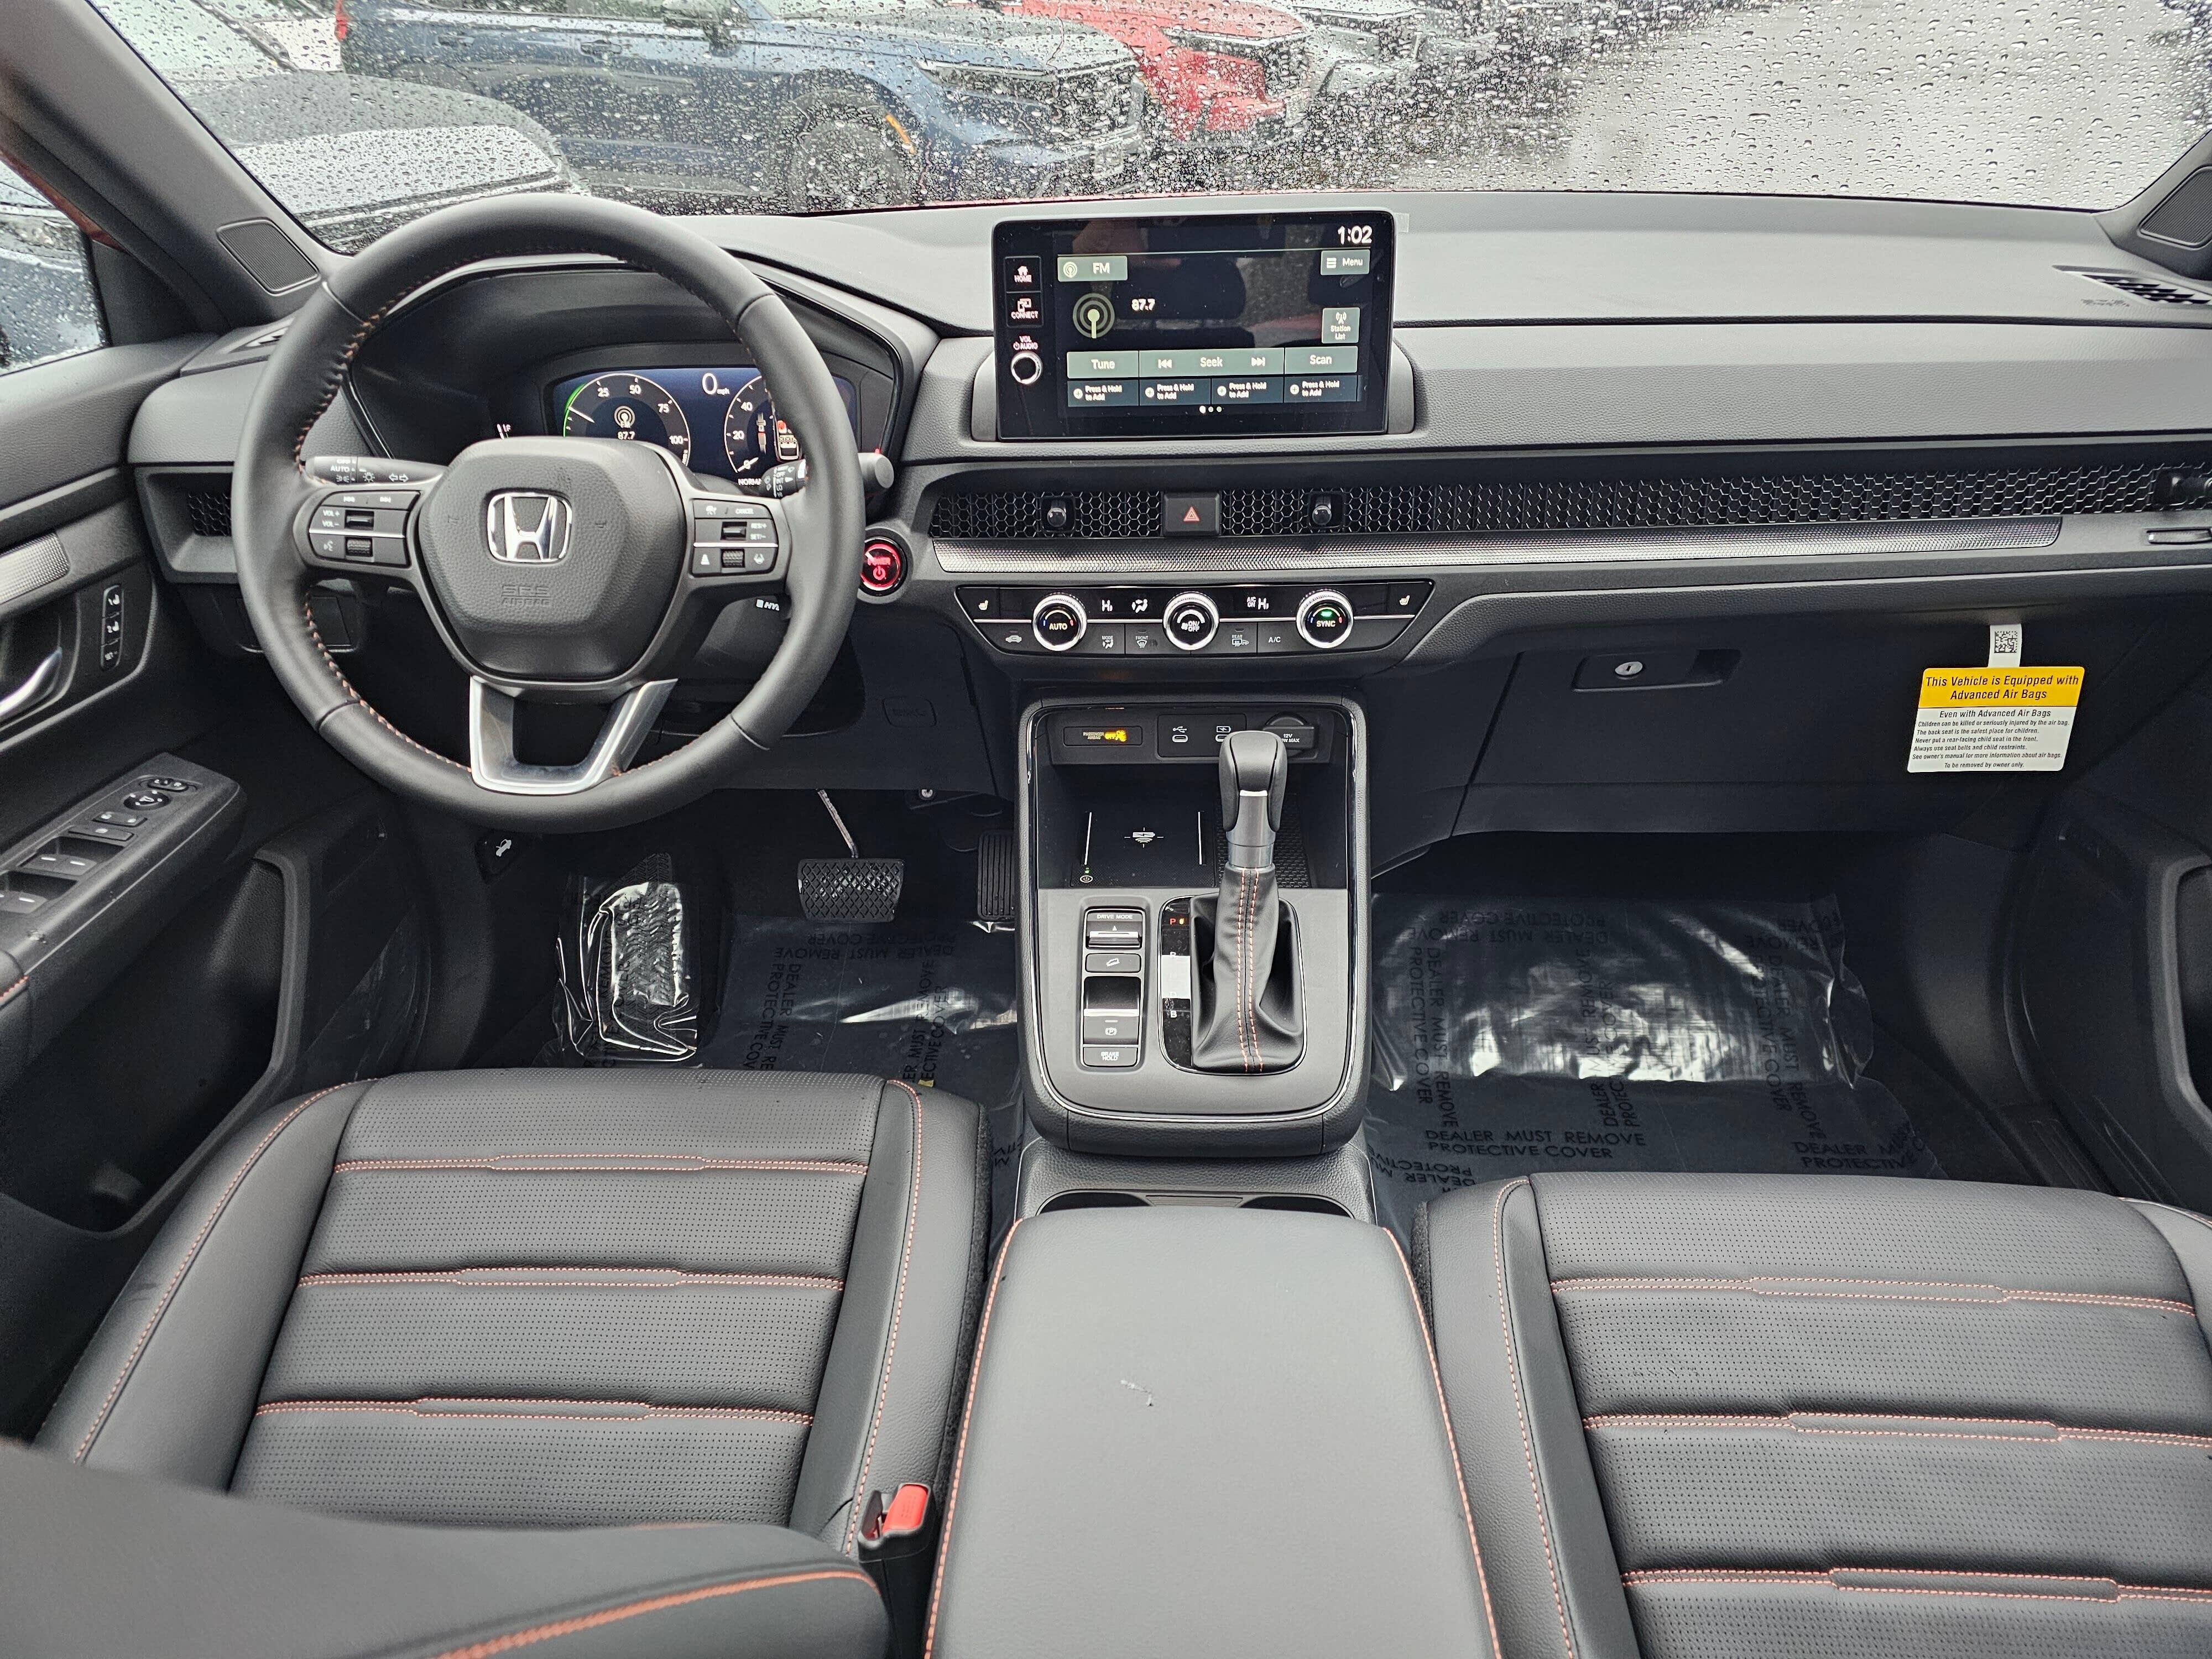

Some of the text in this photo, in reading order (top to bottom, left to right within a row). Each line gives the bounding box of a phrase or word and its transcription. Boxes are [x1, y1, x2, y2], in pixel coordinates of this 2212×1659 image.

[1337, 225, 1373, 244] 1:02
[1093, 262, 1110, 274] FM
[1342, 258, 1363, 266] Menu
[1131, 299, 1155, 311] 87.7
[1011, 311, 1039, 319] CONNECT
[1091, 359, 1115, 369] Tune
[1200, 357, 1223, 367] Seek
[1310, 354, 1332, 365] Scan
[629, 384, 641, 394] 50
[702, 373, 730, 395] 0 mph
[598, 387, 609, 397] 25
[658, 403, 670, 413] 75
[740, 401, 753, 411] 40
[618, 431, 635, 440] 87.7
[669, 436, 684, 445] 100
[732, 430, 744, 440] 20
[1926, 675, 2079, 687] This Vehicle is Equipped with
[1950, 689, 2047, 700] Advanced Air Bags
[2032, 709, 2051, 718] Bags
[807, 933, 862, 945] COVER
[1489, 929, 1533, 942] MUST
[775, 947, 840, 959] REMOVE
[850, 946, 888, 959] MUST
[754, 964, 785, 1040] PROTECTIVE
[768, 964, 801, 1050] DEALER MUST
[931, 986, 947, 1039] COVER
[1410, 947, 1433, 1104] PROTECTIVE COVER
[1427, 947, 1458, 1128] DEALER MUST REMOVE
[908, 1030, 925, 1058] MUST
[1780, 1027, 1799, 1070] MUST
[1590, 1083, 1619, 1127] DEALER
[1425, 1129, 1646, 1145] DEALER MUST REMOVE
[1428, 1142, 1613, 1159] PROTECTIVE COVER
[1793, 1141, 1867, 1155] DEALER
[1405, 1172, 1476, 1187] DEALER
